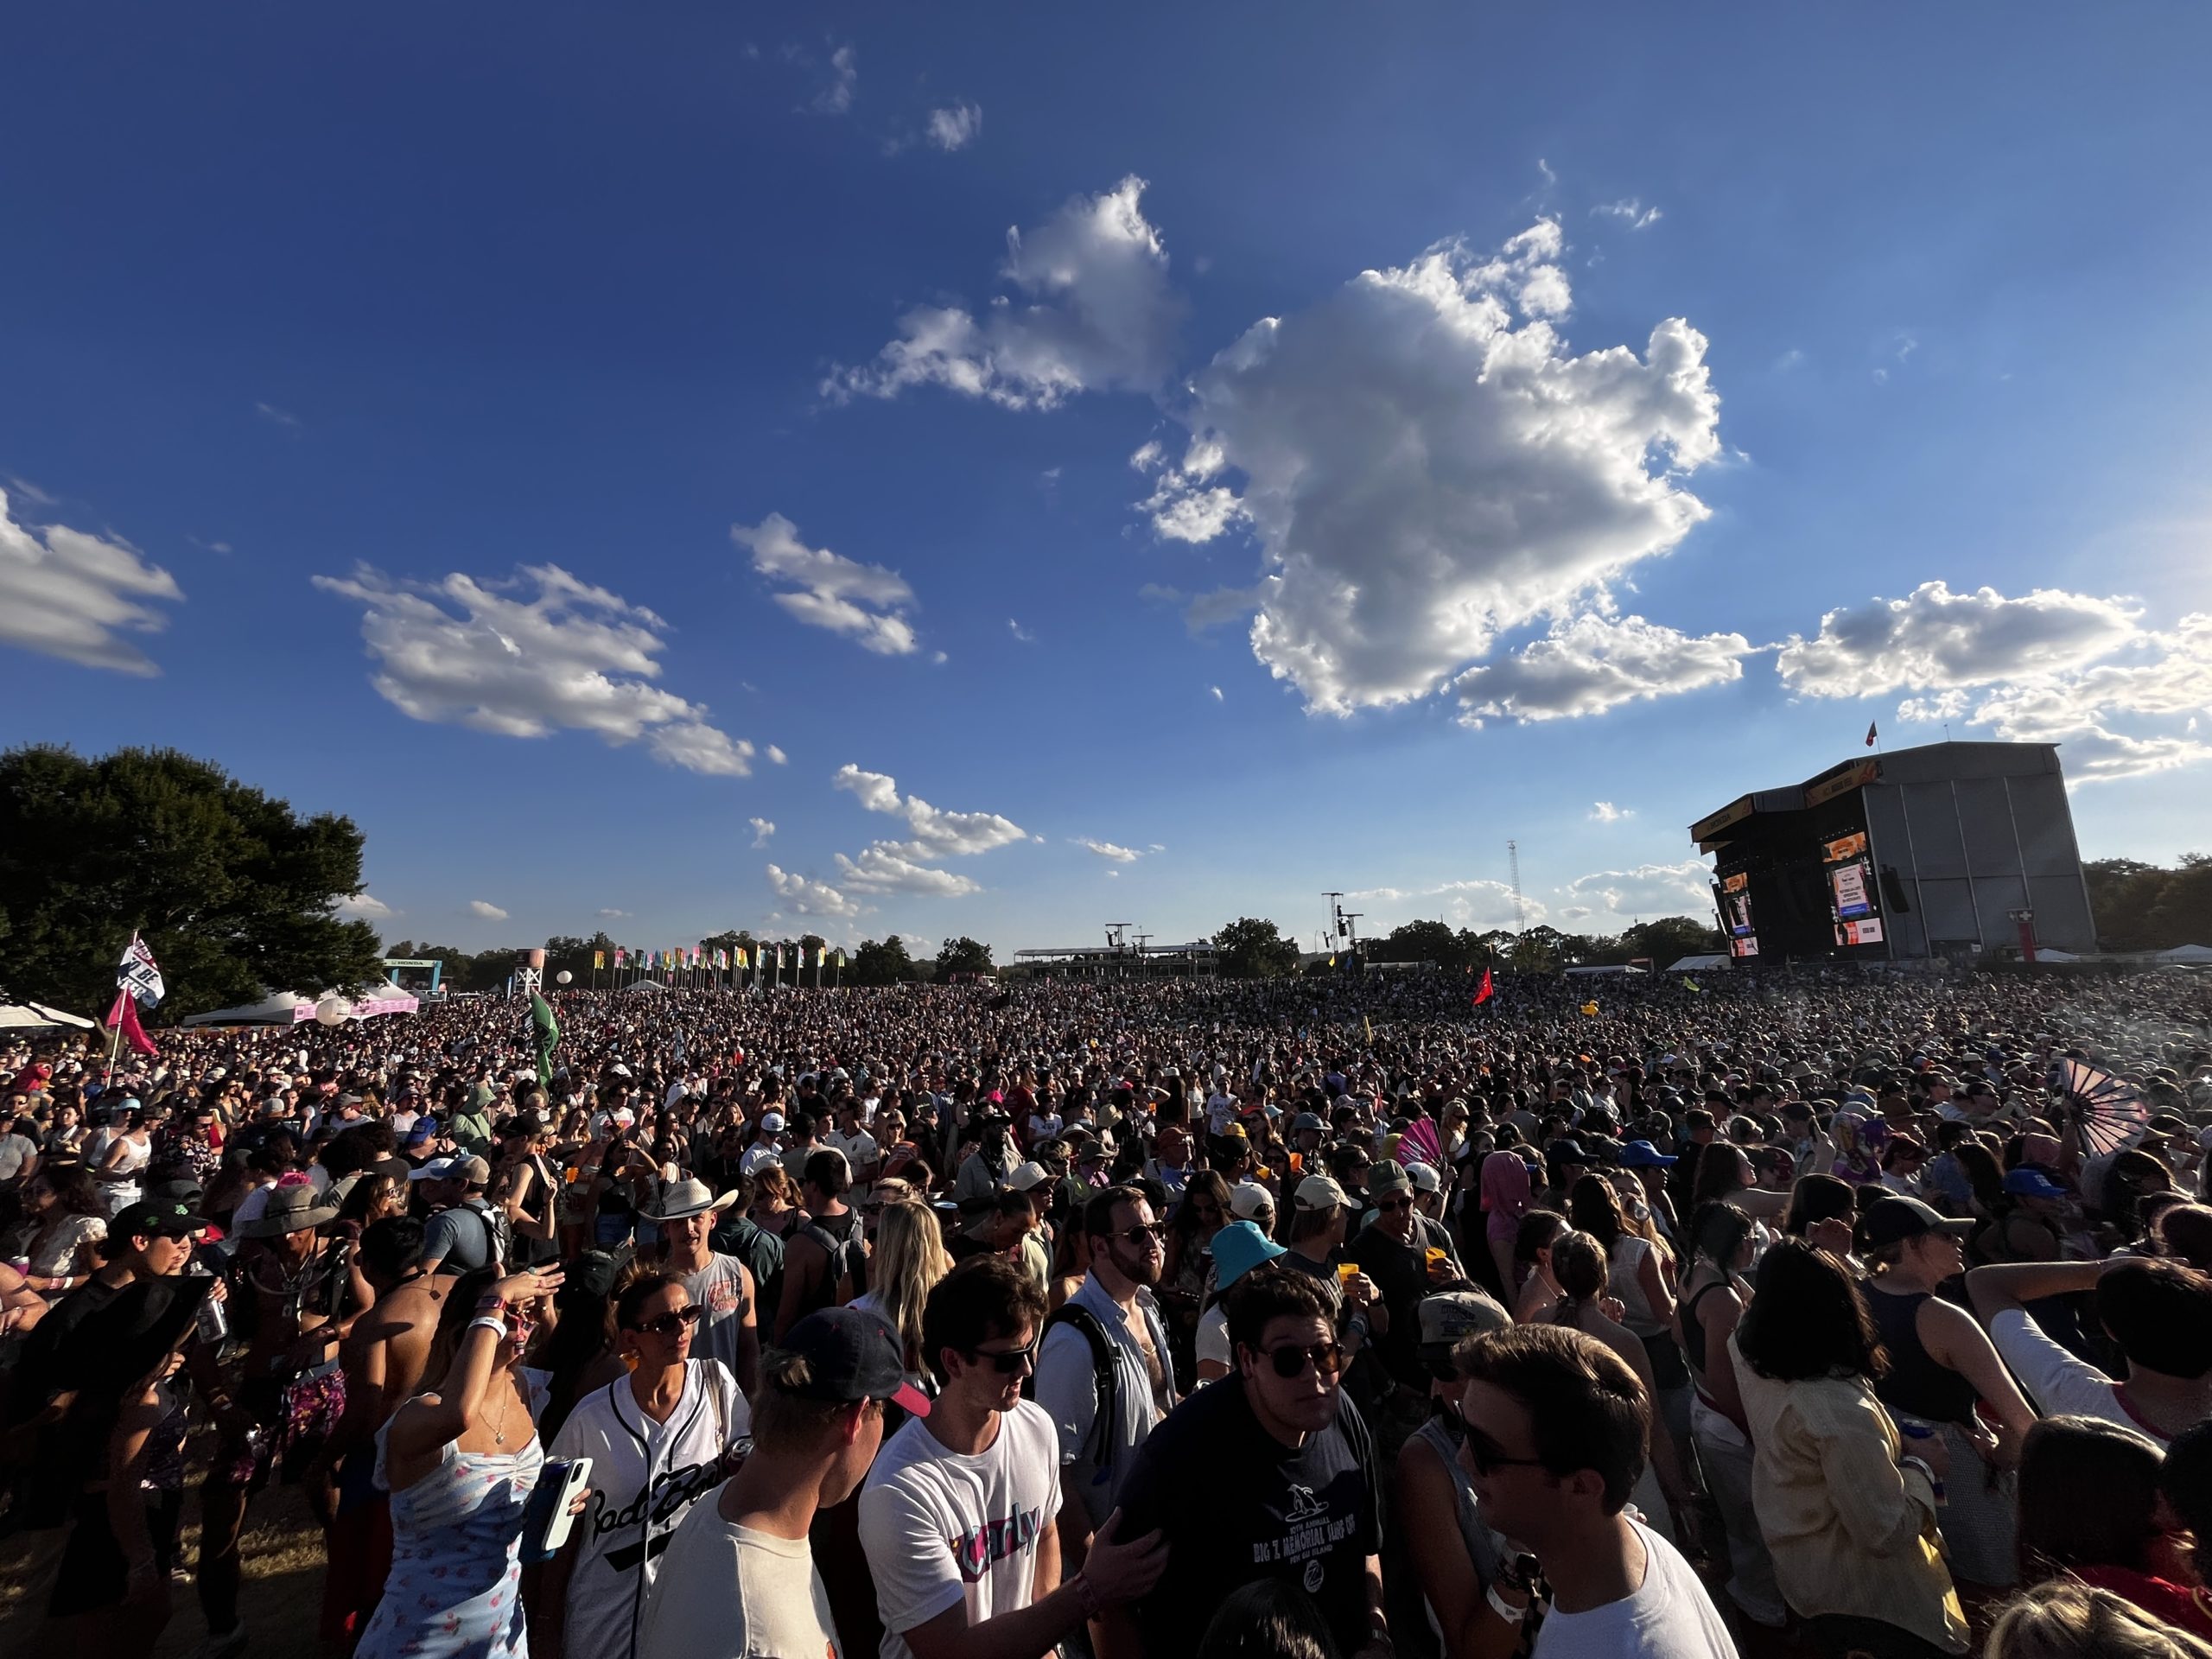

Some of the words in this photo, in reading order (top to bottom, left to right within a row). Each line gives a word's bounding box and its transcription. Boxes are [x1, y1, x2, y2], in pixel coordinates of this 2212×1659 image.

[137, 968, 159, 985] BE
[1253, 1541, 1270, 1563] BIG
[1272, 1539, 1281, 1560] Z
[1282, 1526, 1325, 1557] MEMORIAL
